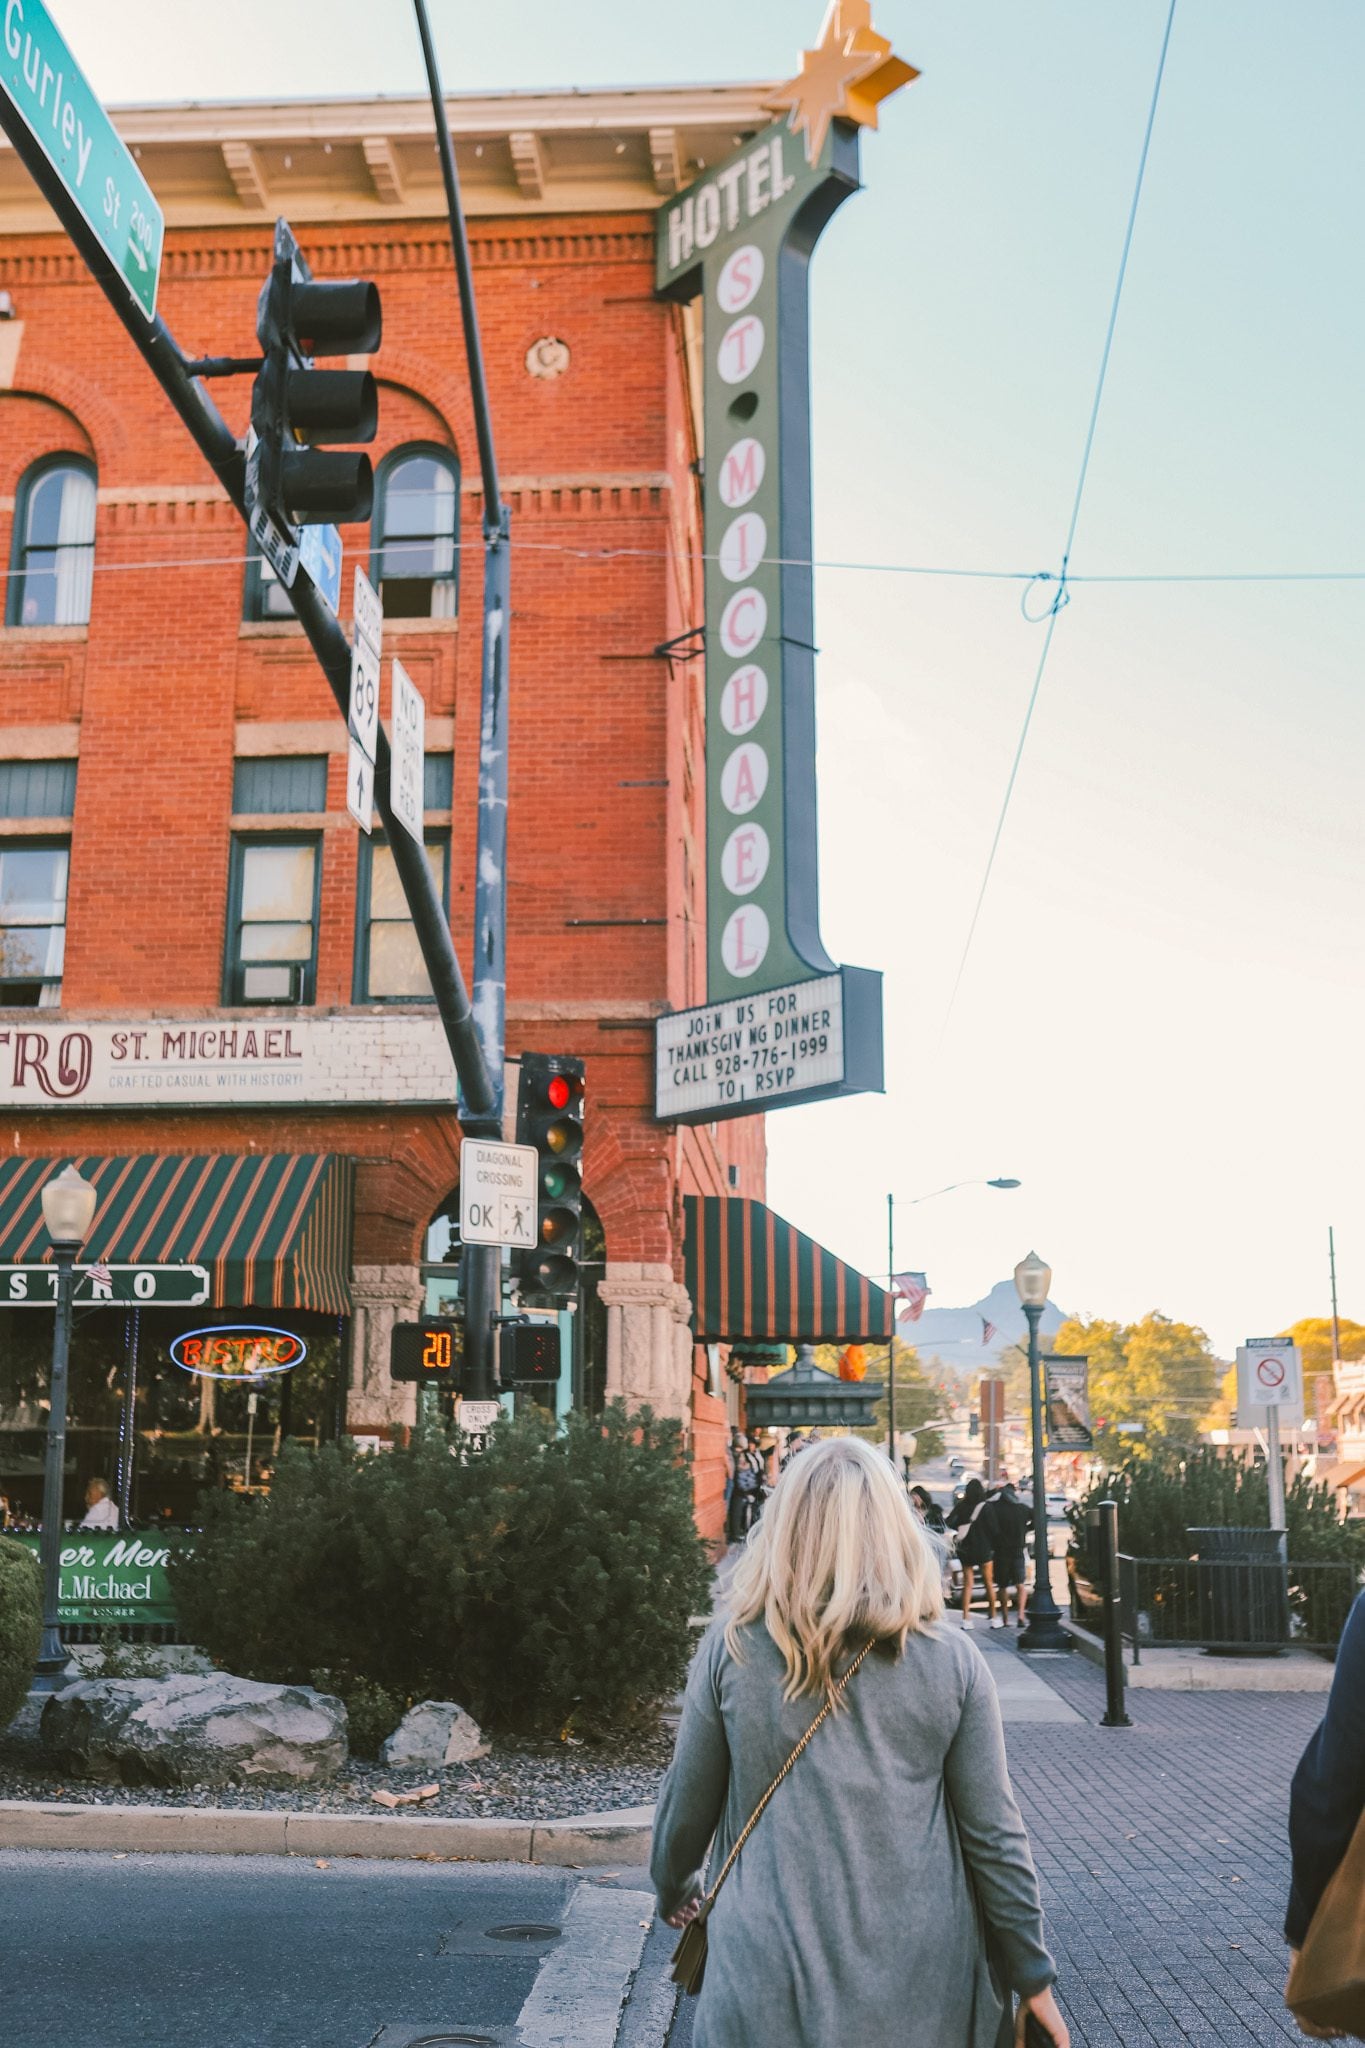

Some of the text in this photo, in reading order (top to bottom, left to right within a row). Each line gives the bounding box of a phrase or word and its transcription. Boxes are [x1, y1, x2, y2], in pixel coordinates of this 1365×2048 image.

[4, 0, 121, 230] Gurley St
[668, 135, 795, 271] HOTEL
[131, 200, 153, 253] 200
[355, 663, 375, 728] 89
[726, 442, 759, 971] MICHAEL
[736, 1003, 755, 1024] US
[768, 993, 797, 1018] FOR
[774, 1010, 831, 1041] DINNER
[110, 1031, 150, 1060] ST.
[161, 1029, 302, 1060] MICHAEL
[673, 1035, 828, 1086] CALL 928-776-1999
[109, 1075, 162, 1088] CRAFTED
[166, 1075, 211, 1088] CASUAL
[217, 1073, 247, 1087] WITH
[718, 1079, 736, 1100] TO
[756, 1066, 796, 1092] RSVP
[476, 1150, 523, 1168] DIAGONAL
[476, 1170, 523, 1188] CROSSING
[469, 1203, 494, 1229] OK
[183, 1336, 297, 1365] BISTRO
[422, 1331, 452, 1368] 20
[103, 1539, 176, 1569] Men
